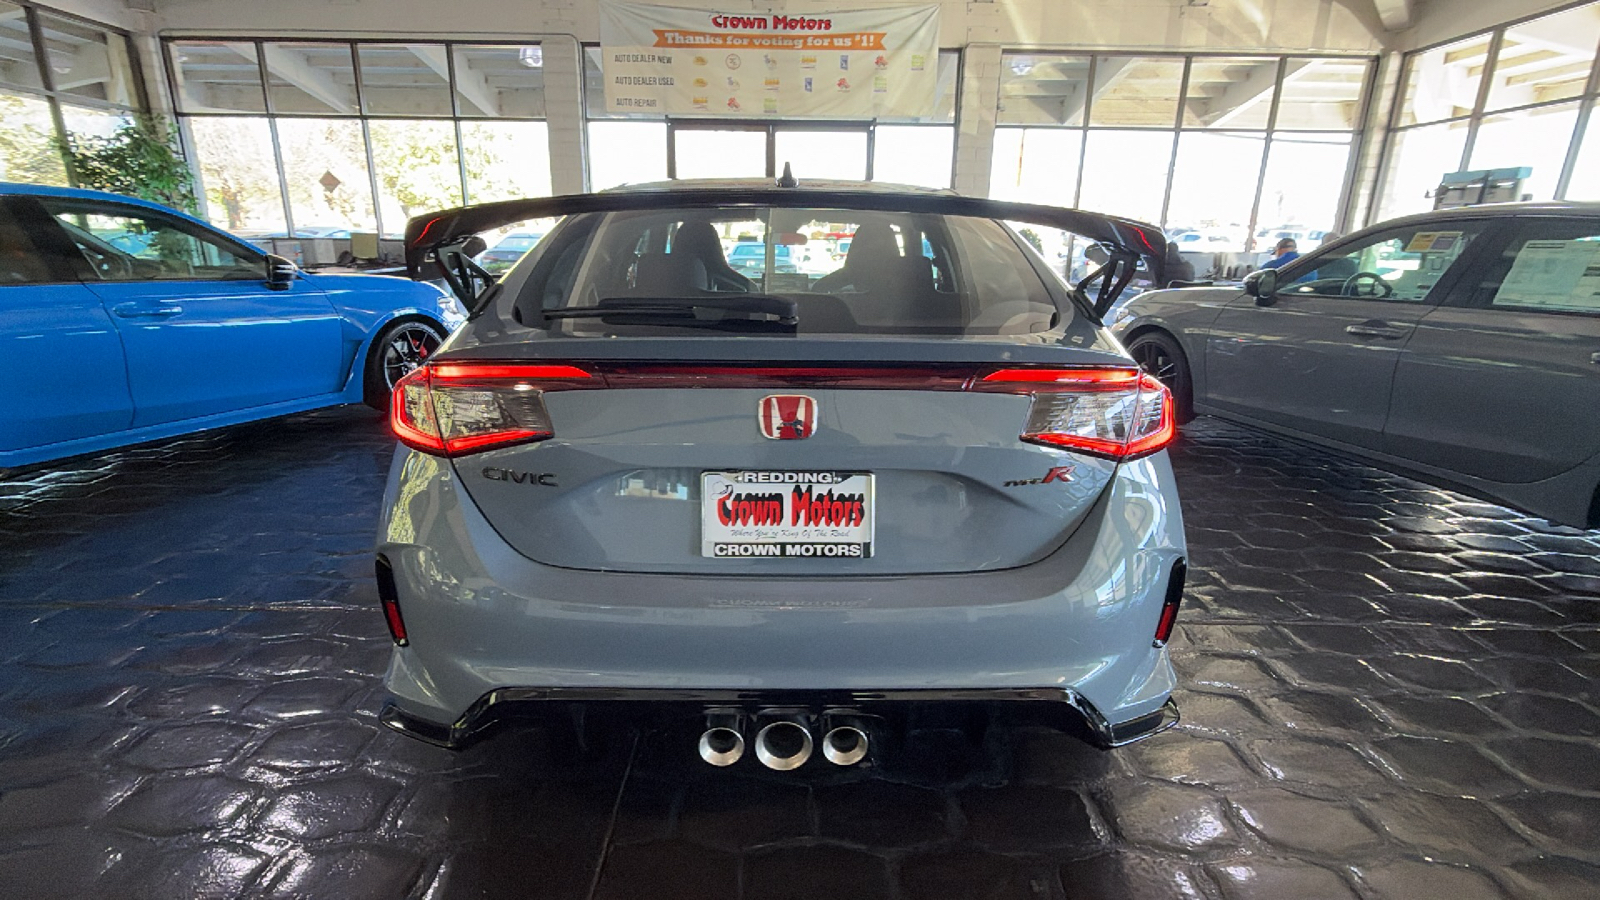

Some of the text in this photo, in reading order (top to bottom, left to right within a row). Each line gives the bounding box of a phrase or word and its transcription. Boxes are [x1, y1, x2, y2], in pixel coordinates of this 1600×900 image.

[712, 15, 832, 30] Crown Motors
[664, 33, 722, 44] Thanks
[726, 34, 749, 45] for
[752, 36, 803, 49] voting
[806, 36, 829, 47] for
[833, 36, 852, 47] us
[615, 54, 672, 64] AUTO DEALER NEW
[615, 76, 674, 86] AUTO DEALER USED
[616, 98, 657, 107] AUTO REPAIR
[482, 466, 559, 487] CIVIC
[744, 472, 832, 483] REDDING
[717, 485, 865, 527] Crown Motors
[730, 529, 754, 537] Where
[781, 529, 800, 539] King
[801, 529, 814, 539] Of
[814, 529, 829, 537] The
[830, 529, 851, 537] Road
[715, 544, 861, 556] CROWN MOTORS
